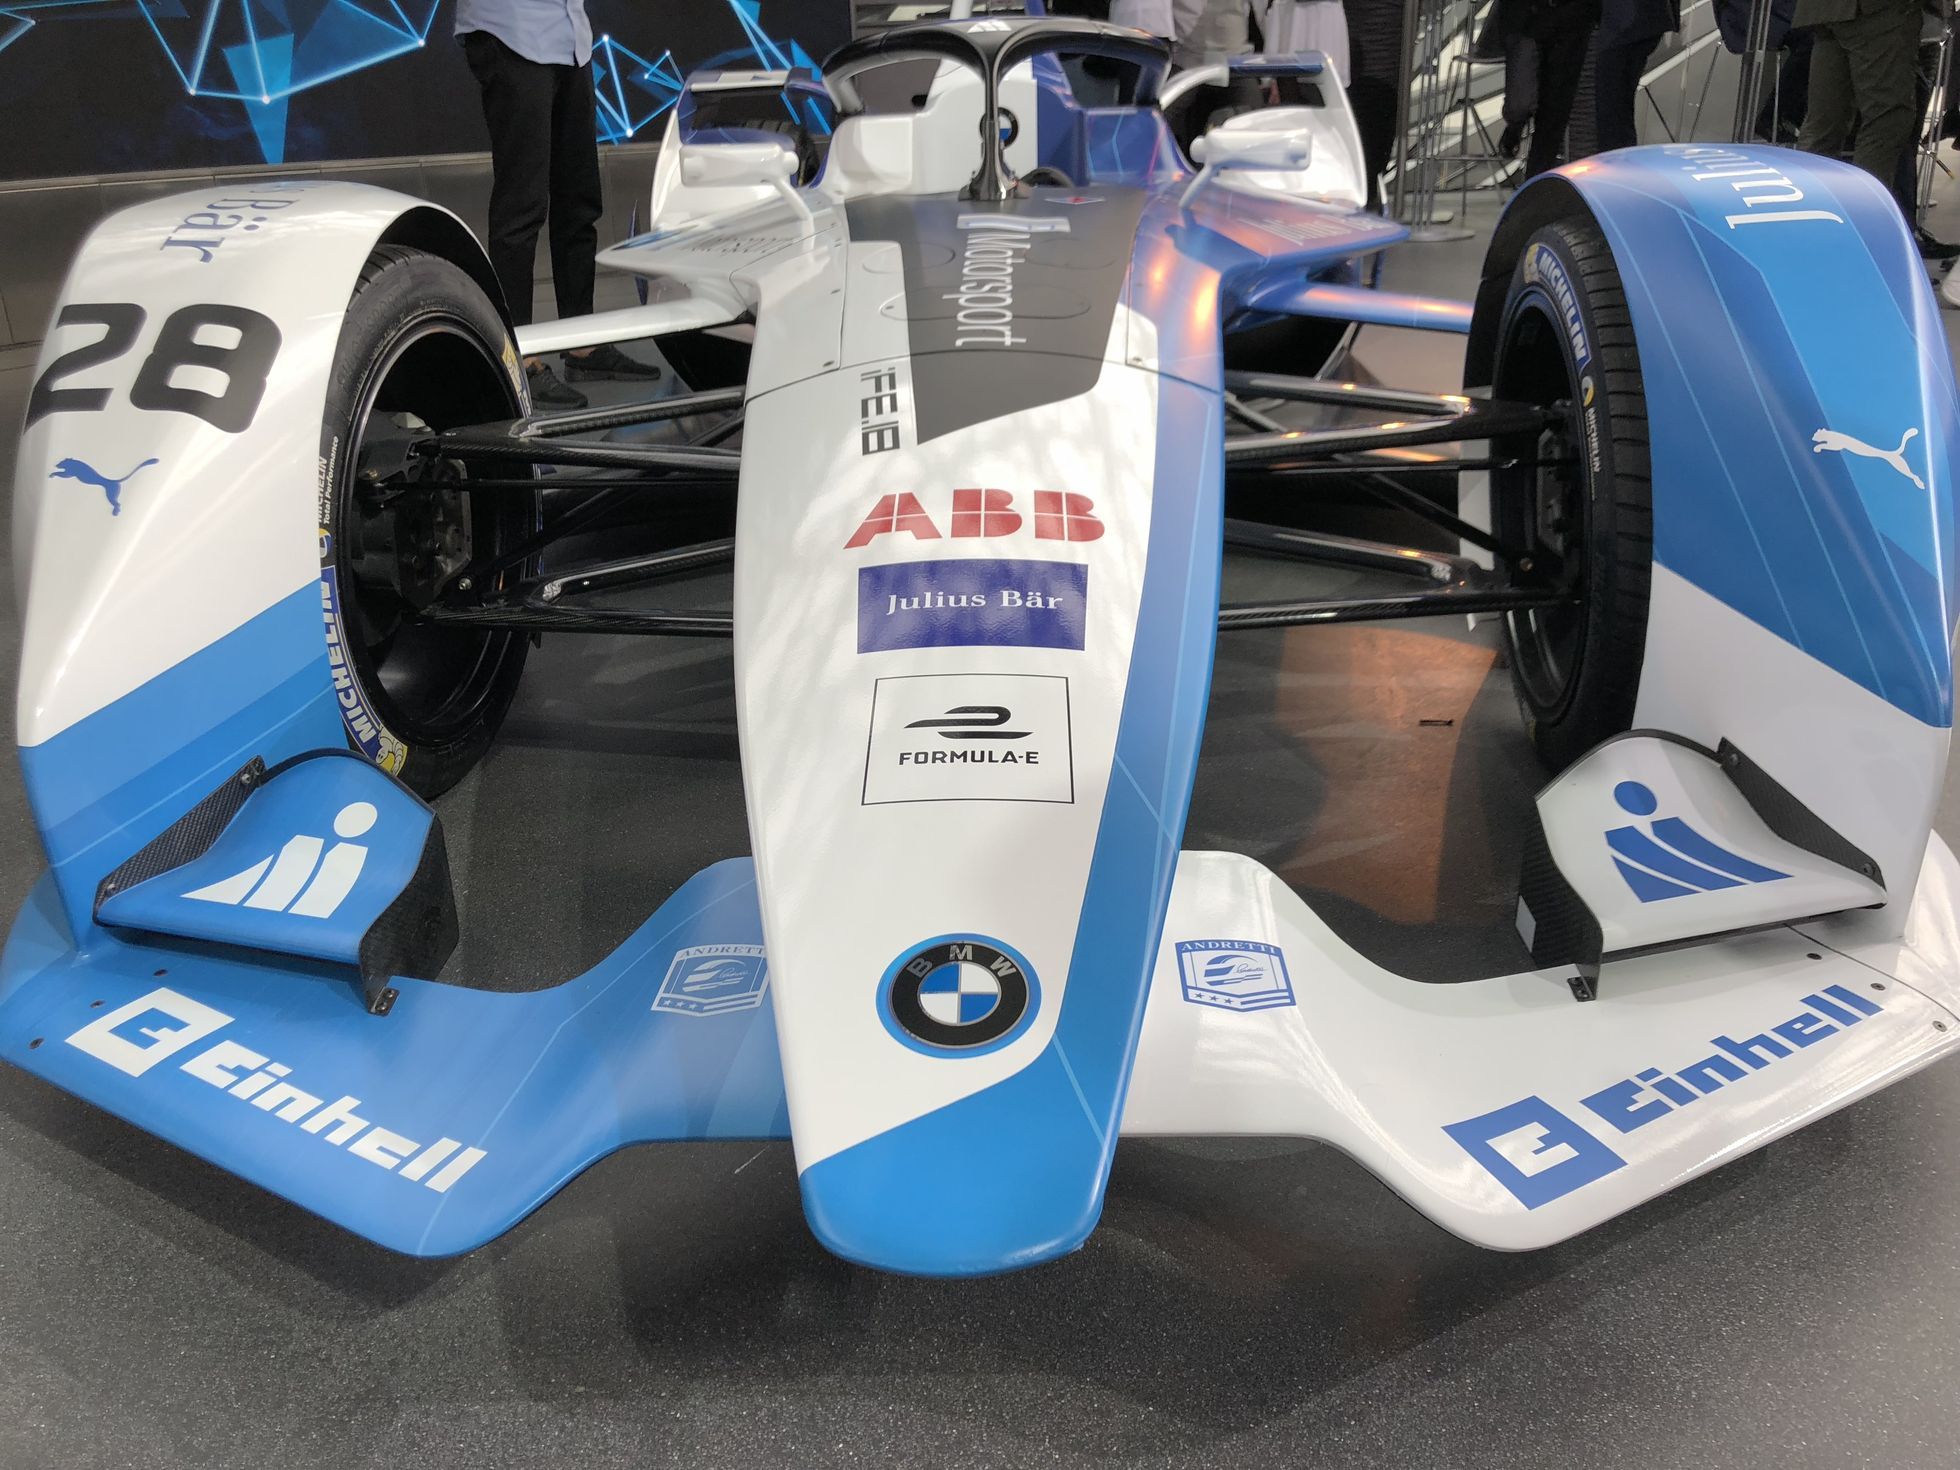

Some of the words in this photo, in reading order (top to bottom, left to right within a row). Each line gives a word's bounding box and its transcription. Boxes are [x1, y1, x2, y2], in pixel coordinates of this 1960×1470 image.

[160, 198, 300, 263] Bär
[942, 232, 1031, 347] Motorsport
[1539, 251, 1587, 361] MICHELIN
[23, 302, 282, 434] 28
[325, 435, 339, 499] Performance
[1585, 407, 1601, 473] MICHELIN
[323, 500, 332, 525] Total
[842, 488, 1105, 550] ABB
[886, 591, 987, 616] Julius
[1000, 590, 1064, 610] Bär
[320, 581, 377, 744] MICHELIN
[898, 750, 1039, 766] FORMULA-E
[678, 945, 765, 958] ANDRETT
[905, 944, 1017, 979] BMW
[1181, 941, 1278, 955] ANDRETTI
[1580, 984, 1884, 1134] Einhell
[179, 1040, 488, 1193] Einhell
